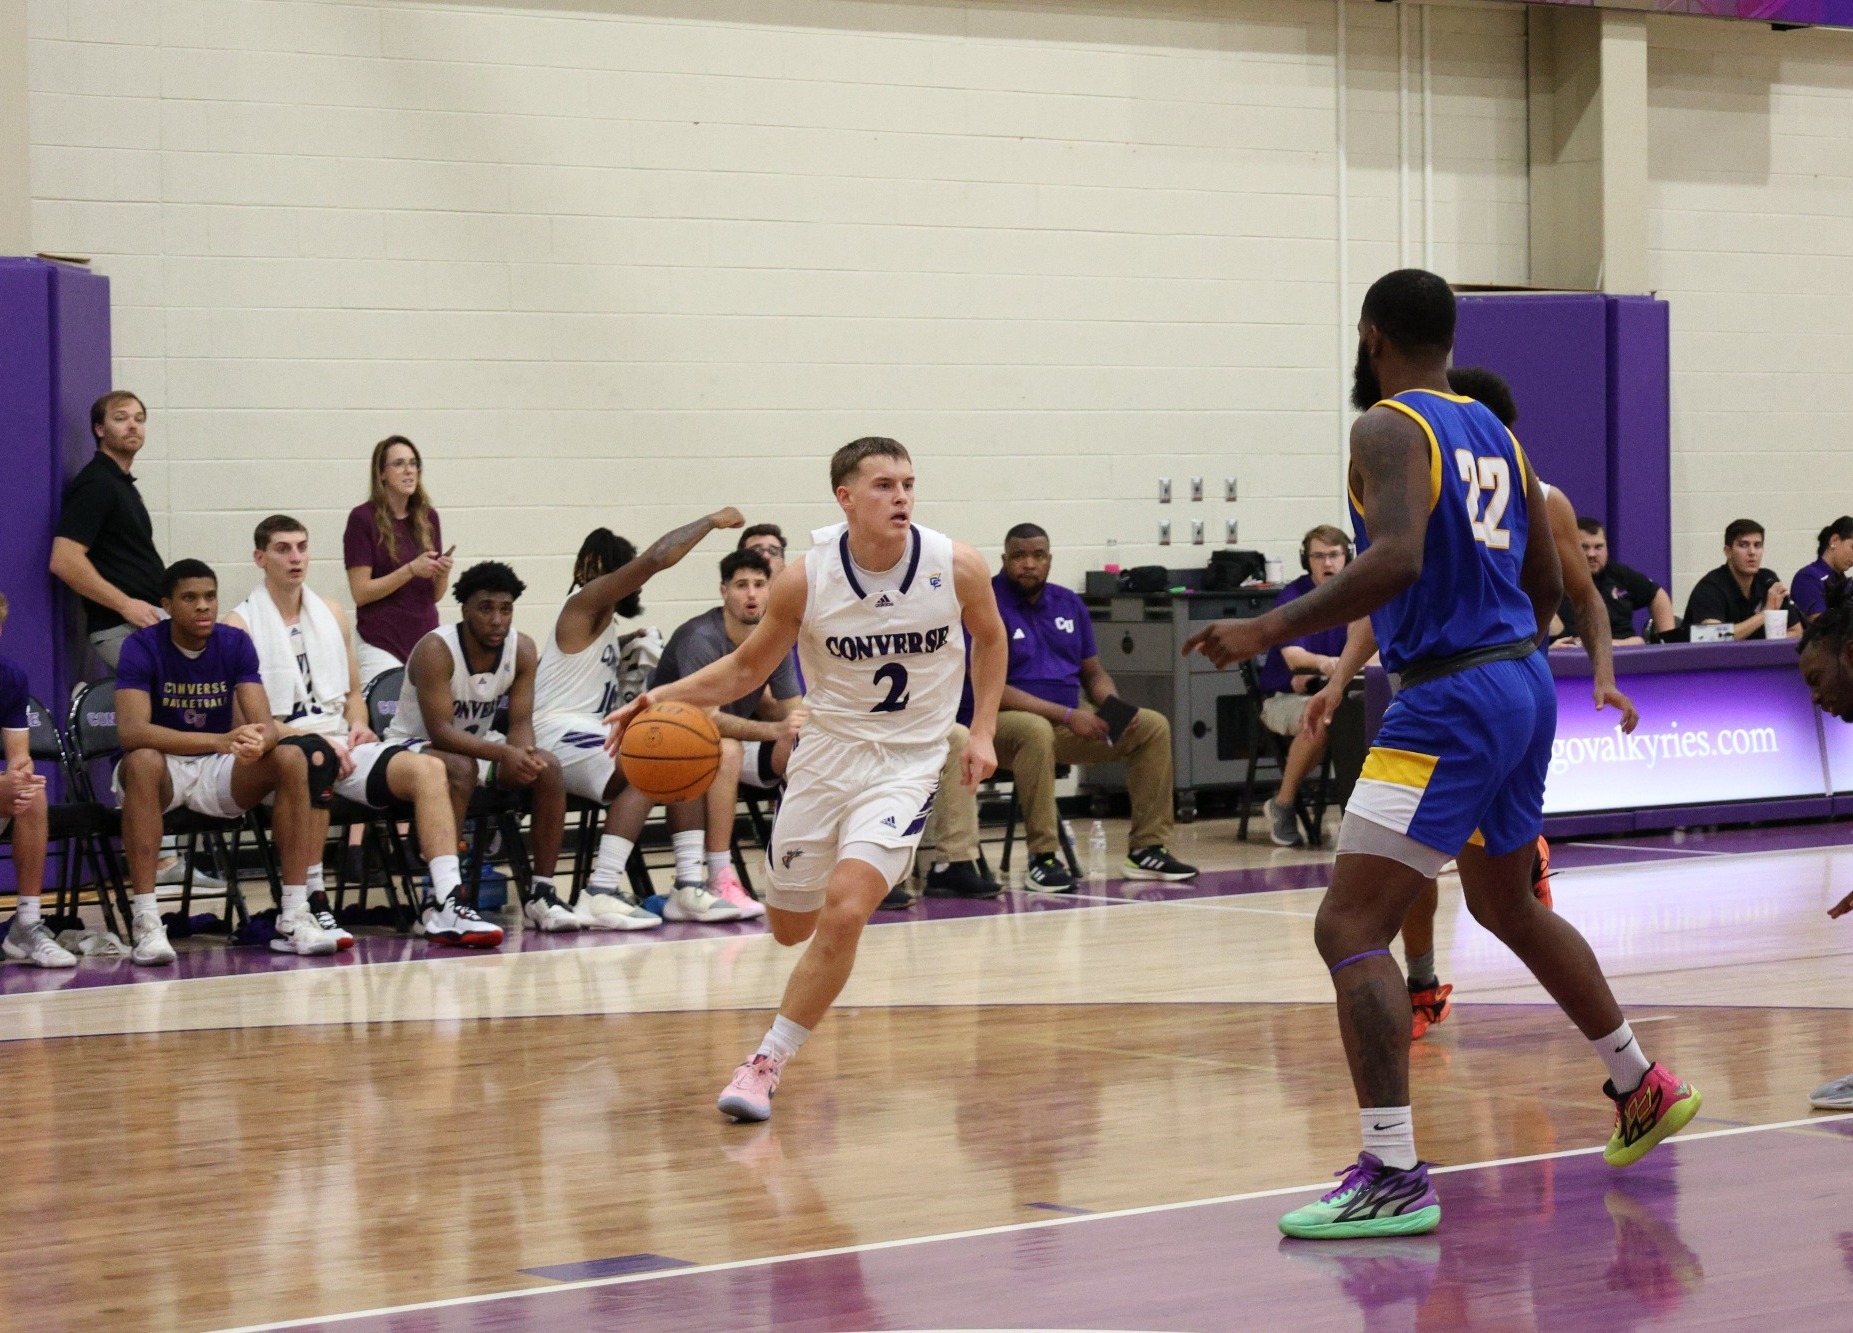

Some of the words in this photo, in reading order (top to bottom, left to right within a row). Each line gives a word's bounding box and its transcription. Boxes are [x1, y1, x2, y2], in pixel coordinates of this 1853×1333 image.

[1454, 448, 1511, 550] 22
[825, 625, 950, 661] CONVERSE
[869, 662, 910, 713] 2
[1551, 720, 1780, 775] govalkyries.com
